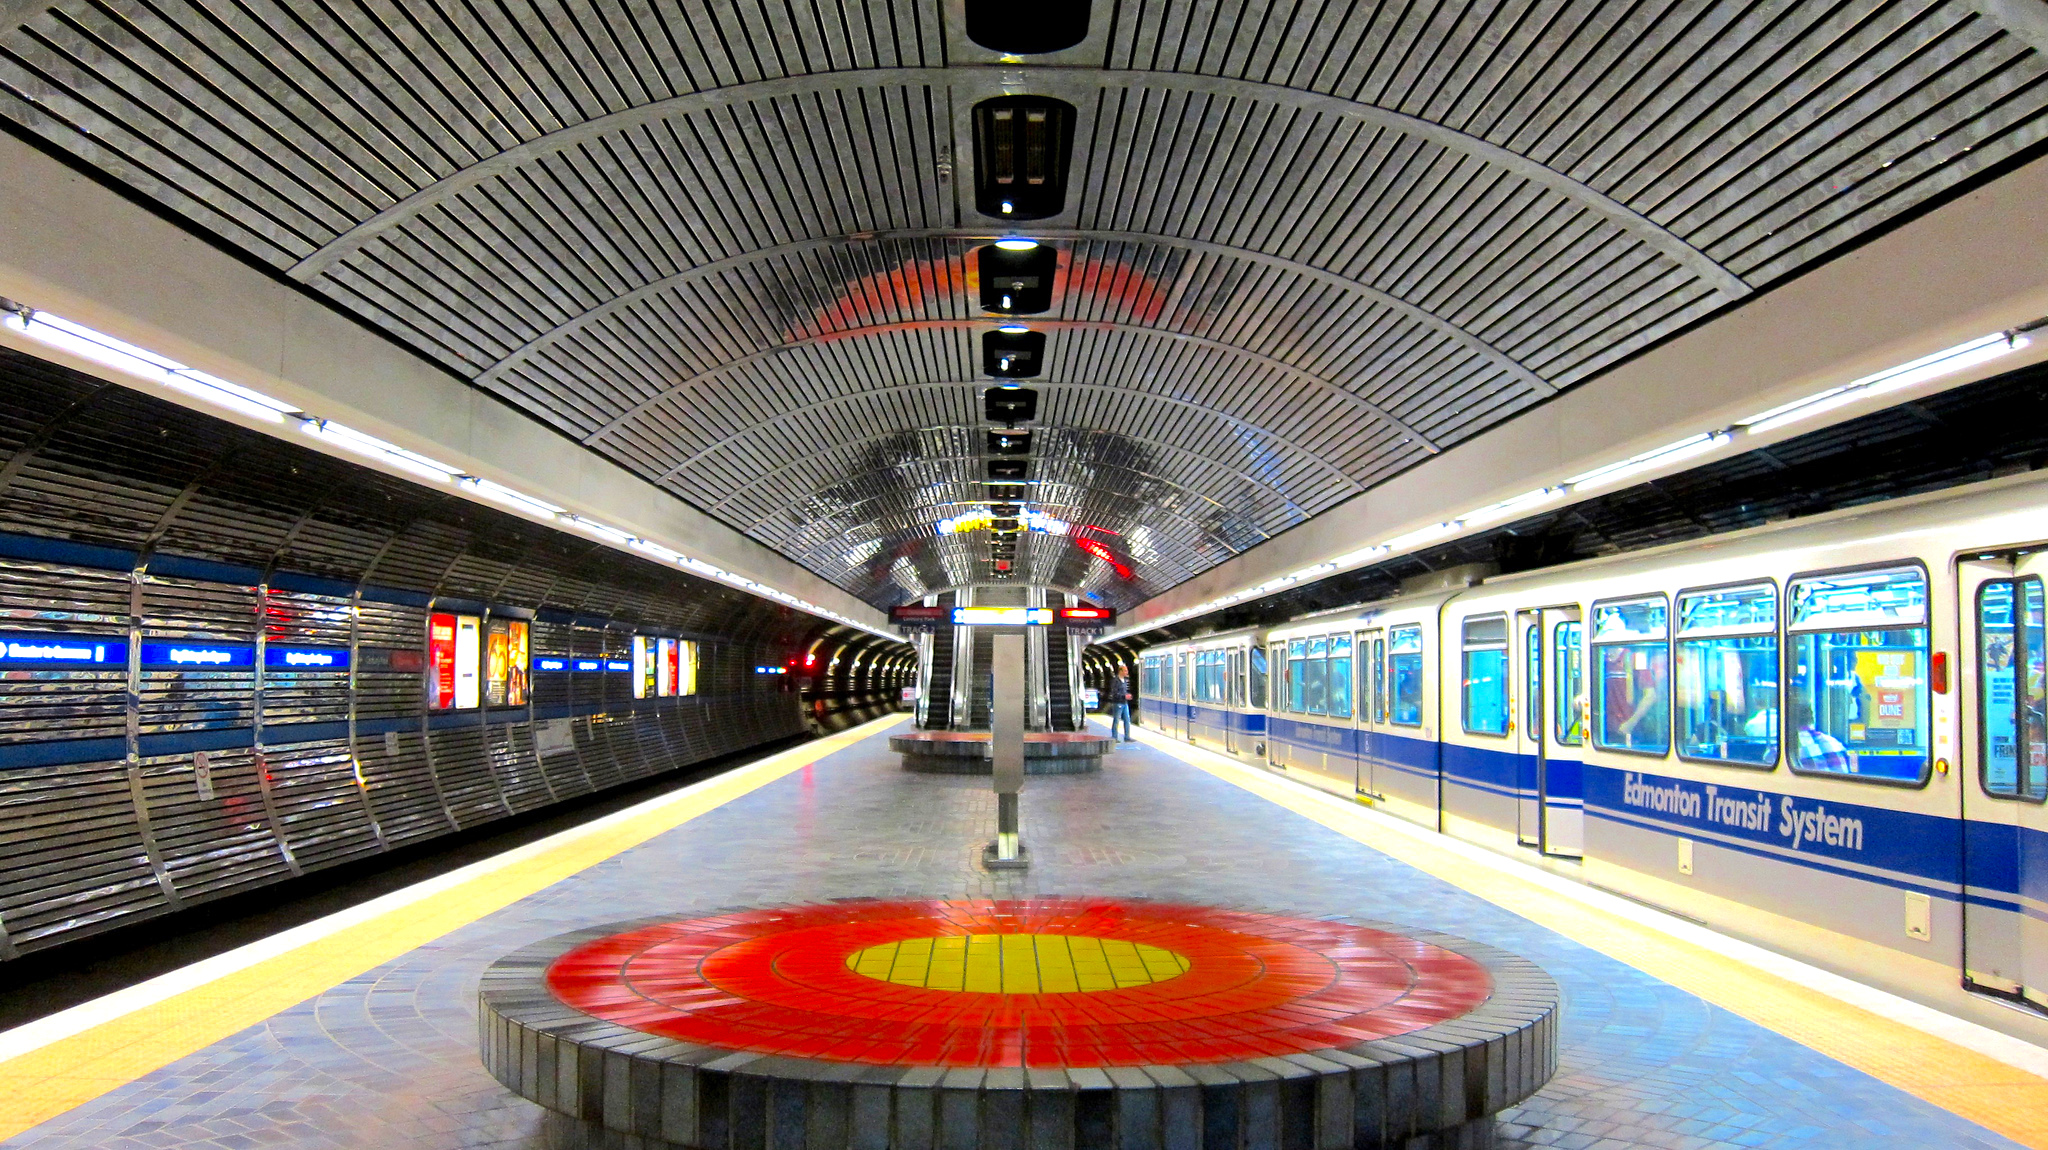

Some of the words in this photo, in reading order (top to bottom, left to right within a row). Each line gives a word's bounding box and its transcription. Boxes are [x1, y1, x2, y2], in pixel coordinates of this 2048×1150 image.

[902, 626, 929, 635] TRACK
[1070, 627, 1097, 635] TRACK
[1624, 772, 1700, 819] Edmonton
[1706, 785, 1772, 832] Transit
[1779, 796, 1863, 850] System
